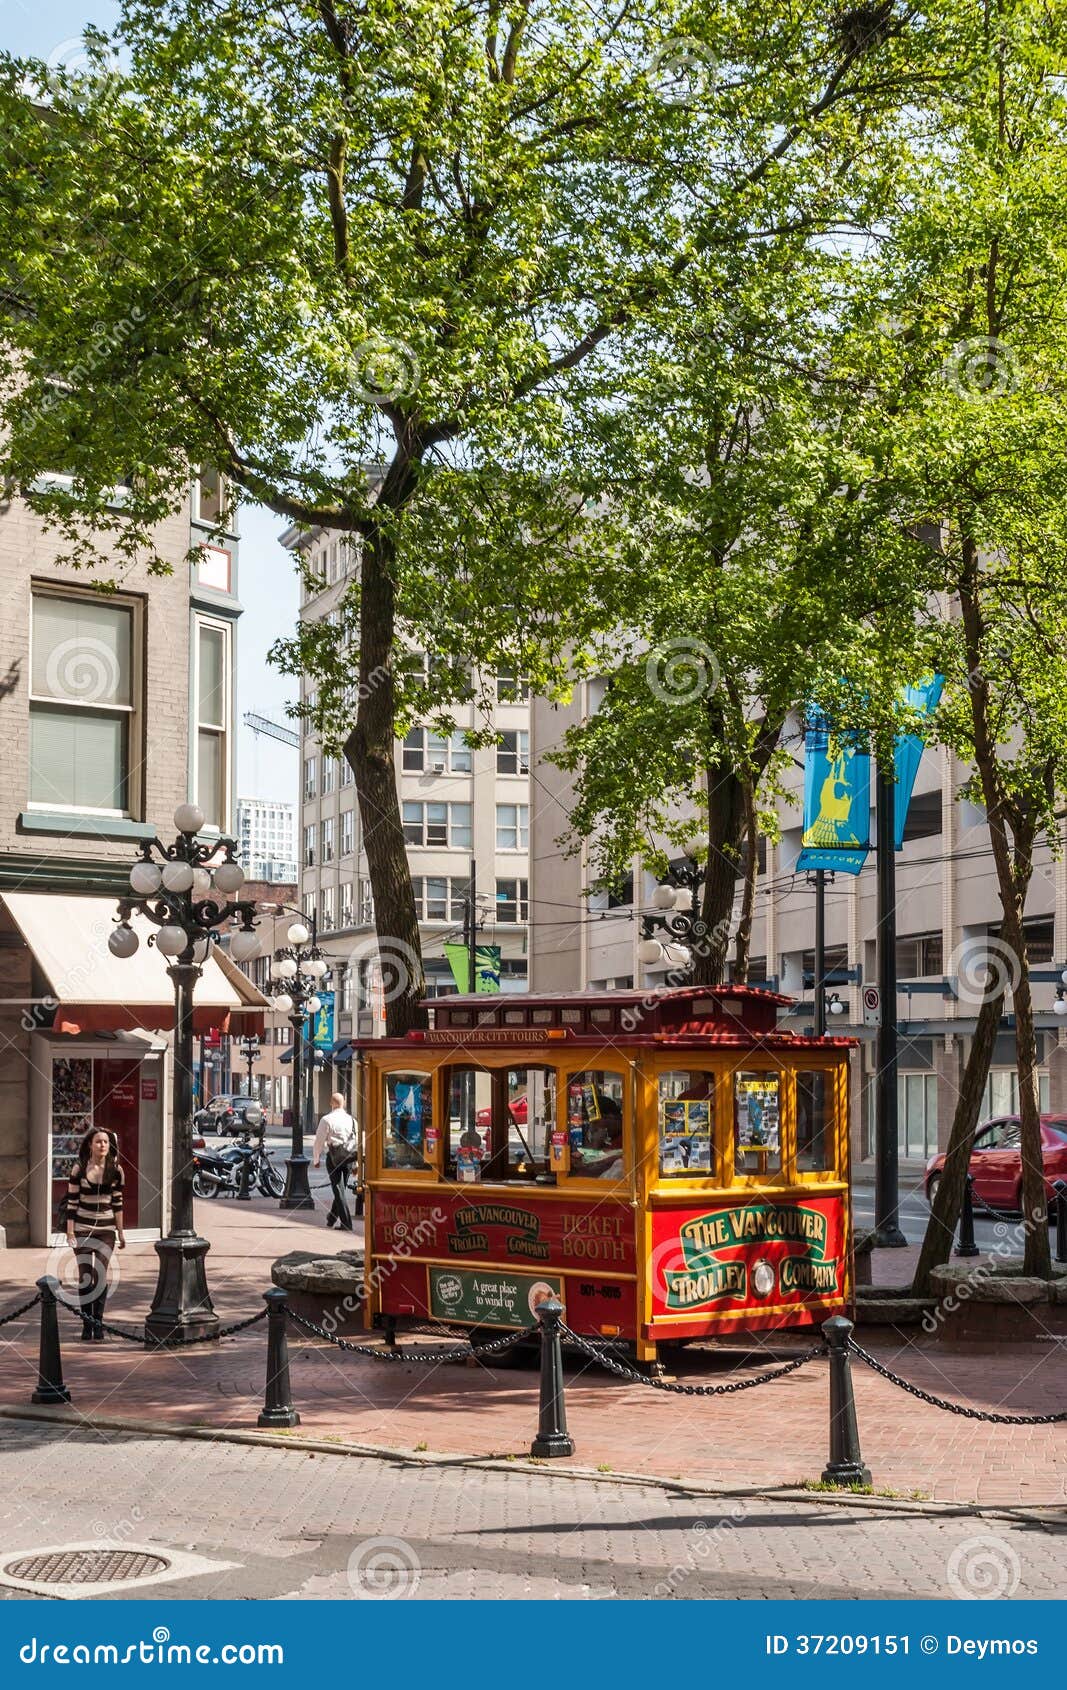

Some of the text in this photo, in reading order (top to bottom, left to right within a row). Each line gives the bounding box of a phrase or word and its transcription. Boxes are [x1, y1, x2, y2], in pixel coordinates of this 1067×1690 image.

[486, 1031, 509, 1041] CITY
[511, 1031, 543, 1041] TOURS
[456, 1206, 537, 1229] THE VANCOUVER
[561, 1215, 624, 1237] TICKET
[685, 1209, 823, 1250] THE VANCOUVER
[450, 1235, 547, 1257] TROLLEY COMPANY
[563, 1238, 625, 1260] BOOTH
[473, 1280, 517, 1297] A great place
[671, 1259, 835, 1303] TROLLEY COMPANY
[476, 1294, 514, 1311] to wind up
